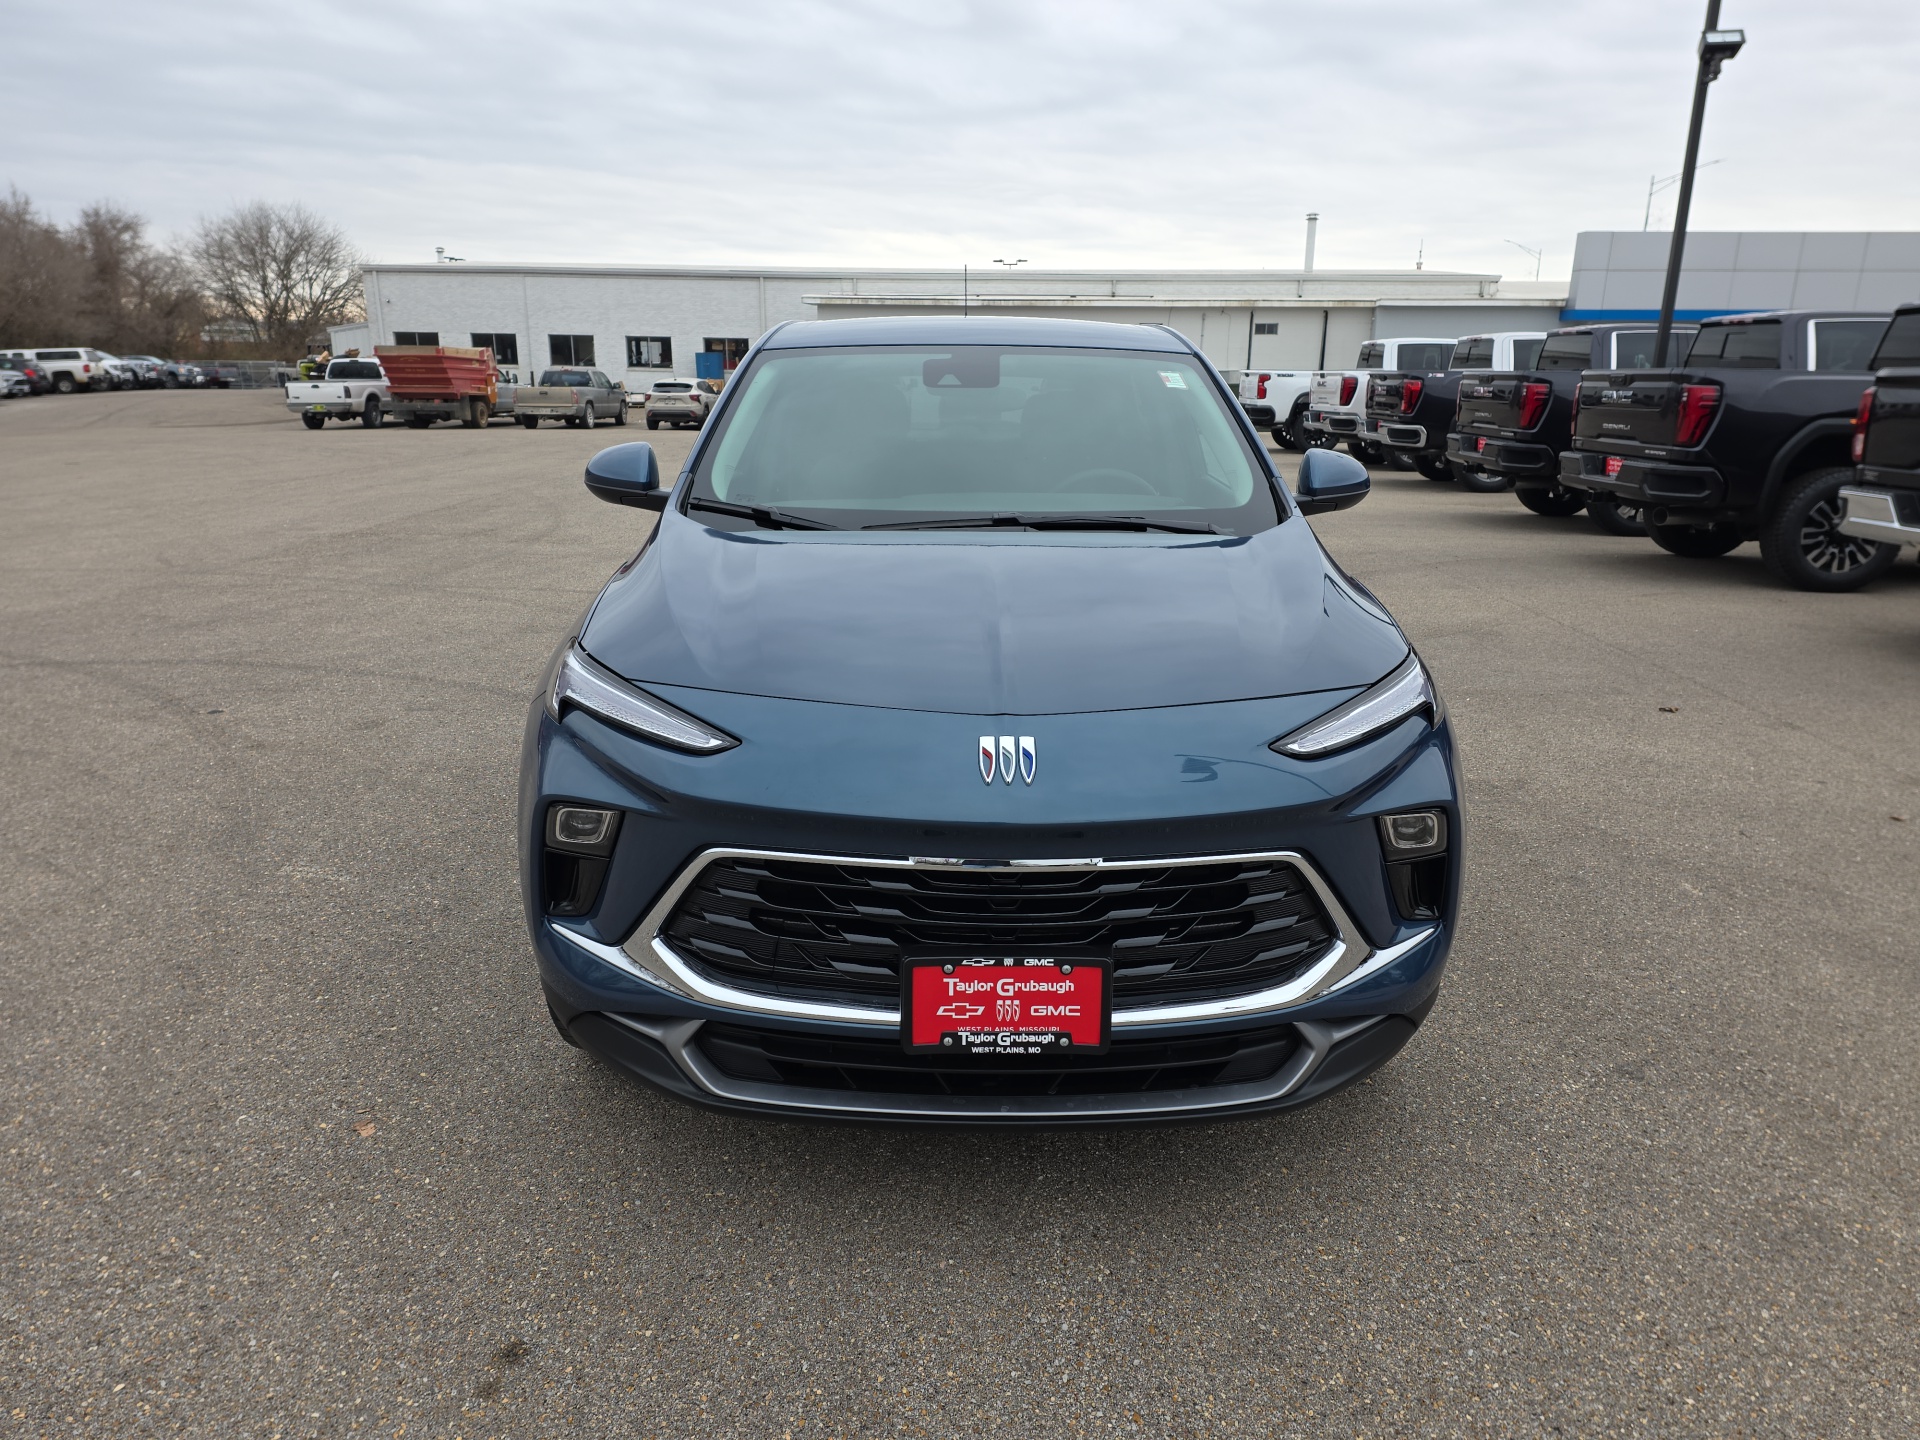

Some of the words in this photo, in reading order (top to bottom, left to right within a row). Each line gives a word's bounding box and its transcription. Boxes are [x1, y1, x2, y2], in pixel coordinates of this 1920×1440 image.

[1601, 390, 1633, 403] GMC
[1024, 958, 1054, 966] GMC
[943, 978, 994, 996] Taylor
[996, 978, 1075, 996] Grubaugh
[1030, 1005, 1081, 1016] GMC
[957, 1032, 995, 1045] Taylor
[997, 1032, 1055, 1045] Grubaugh
